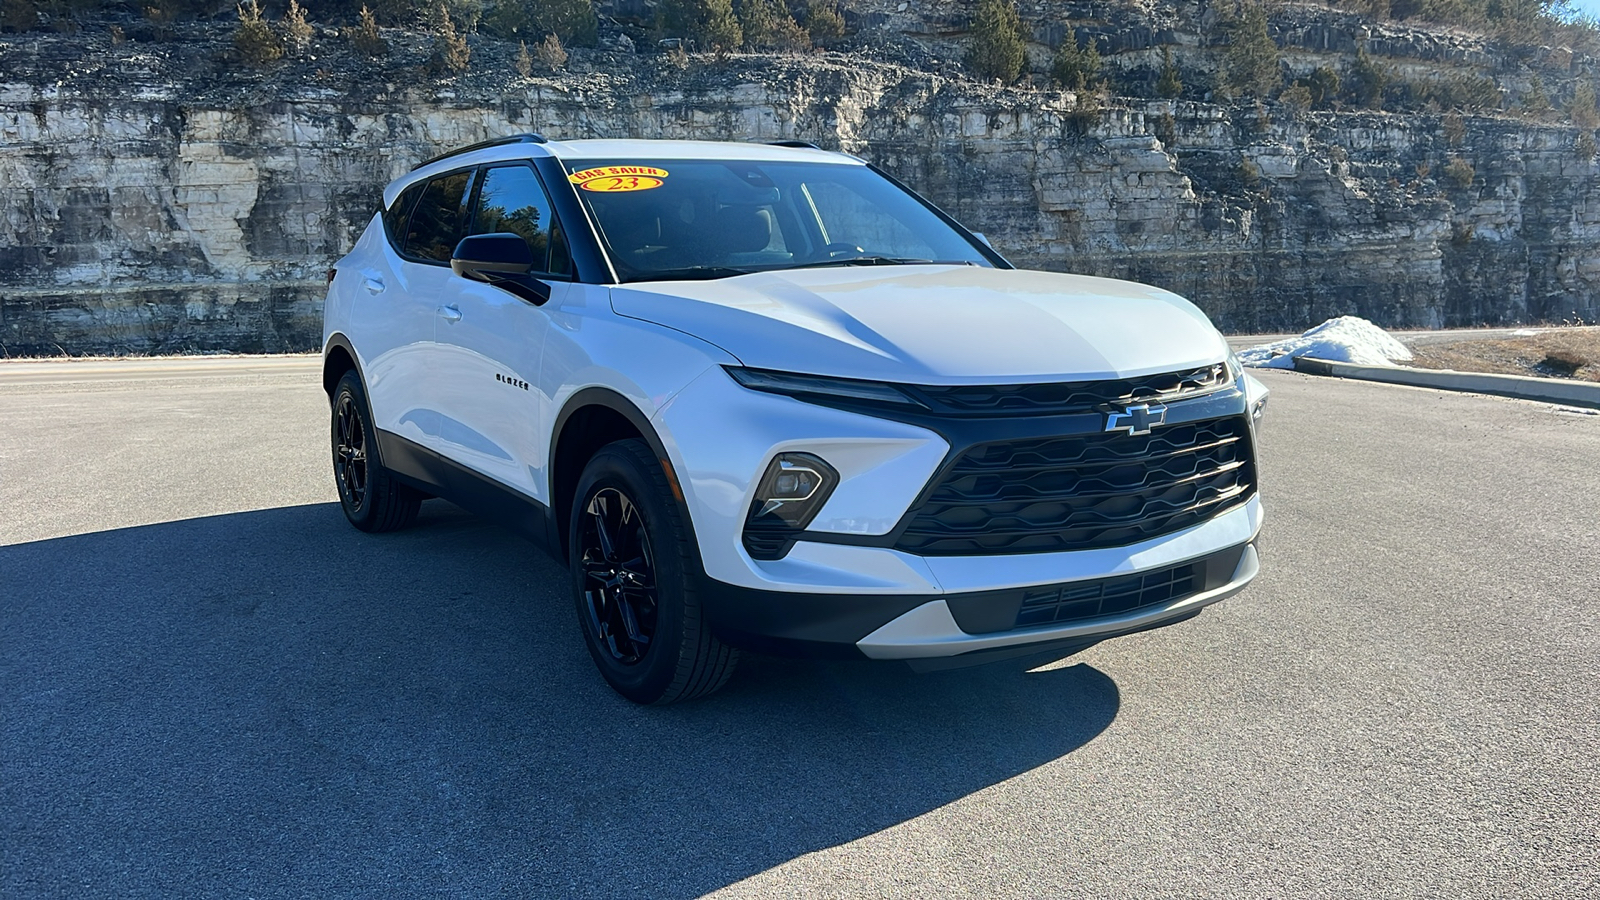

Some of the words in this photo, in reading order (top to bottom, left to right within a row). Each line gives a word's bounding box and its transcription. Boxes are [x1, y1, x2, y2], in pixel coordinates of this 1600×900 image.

[574, 169, 606, 180] GAS
[608, 167, 658, 175] SAVER
[607, 177, 639, 190] 23
[496, 373, 529, 391] BLAZER
